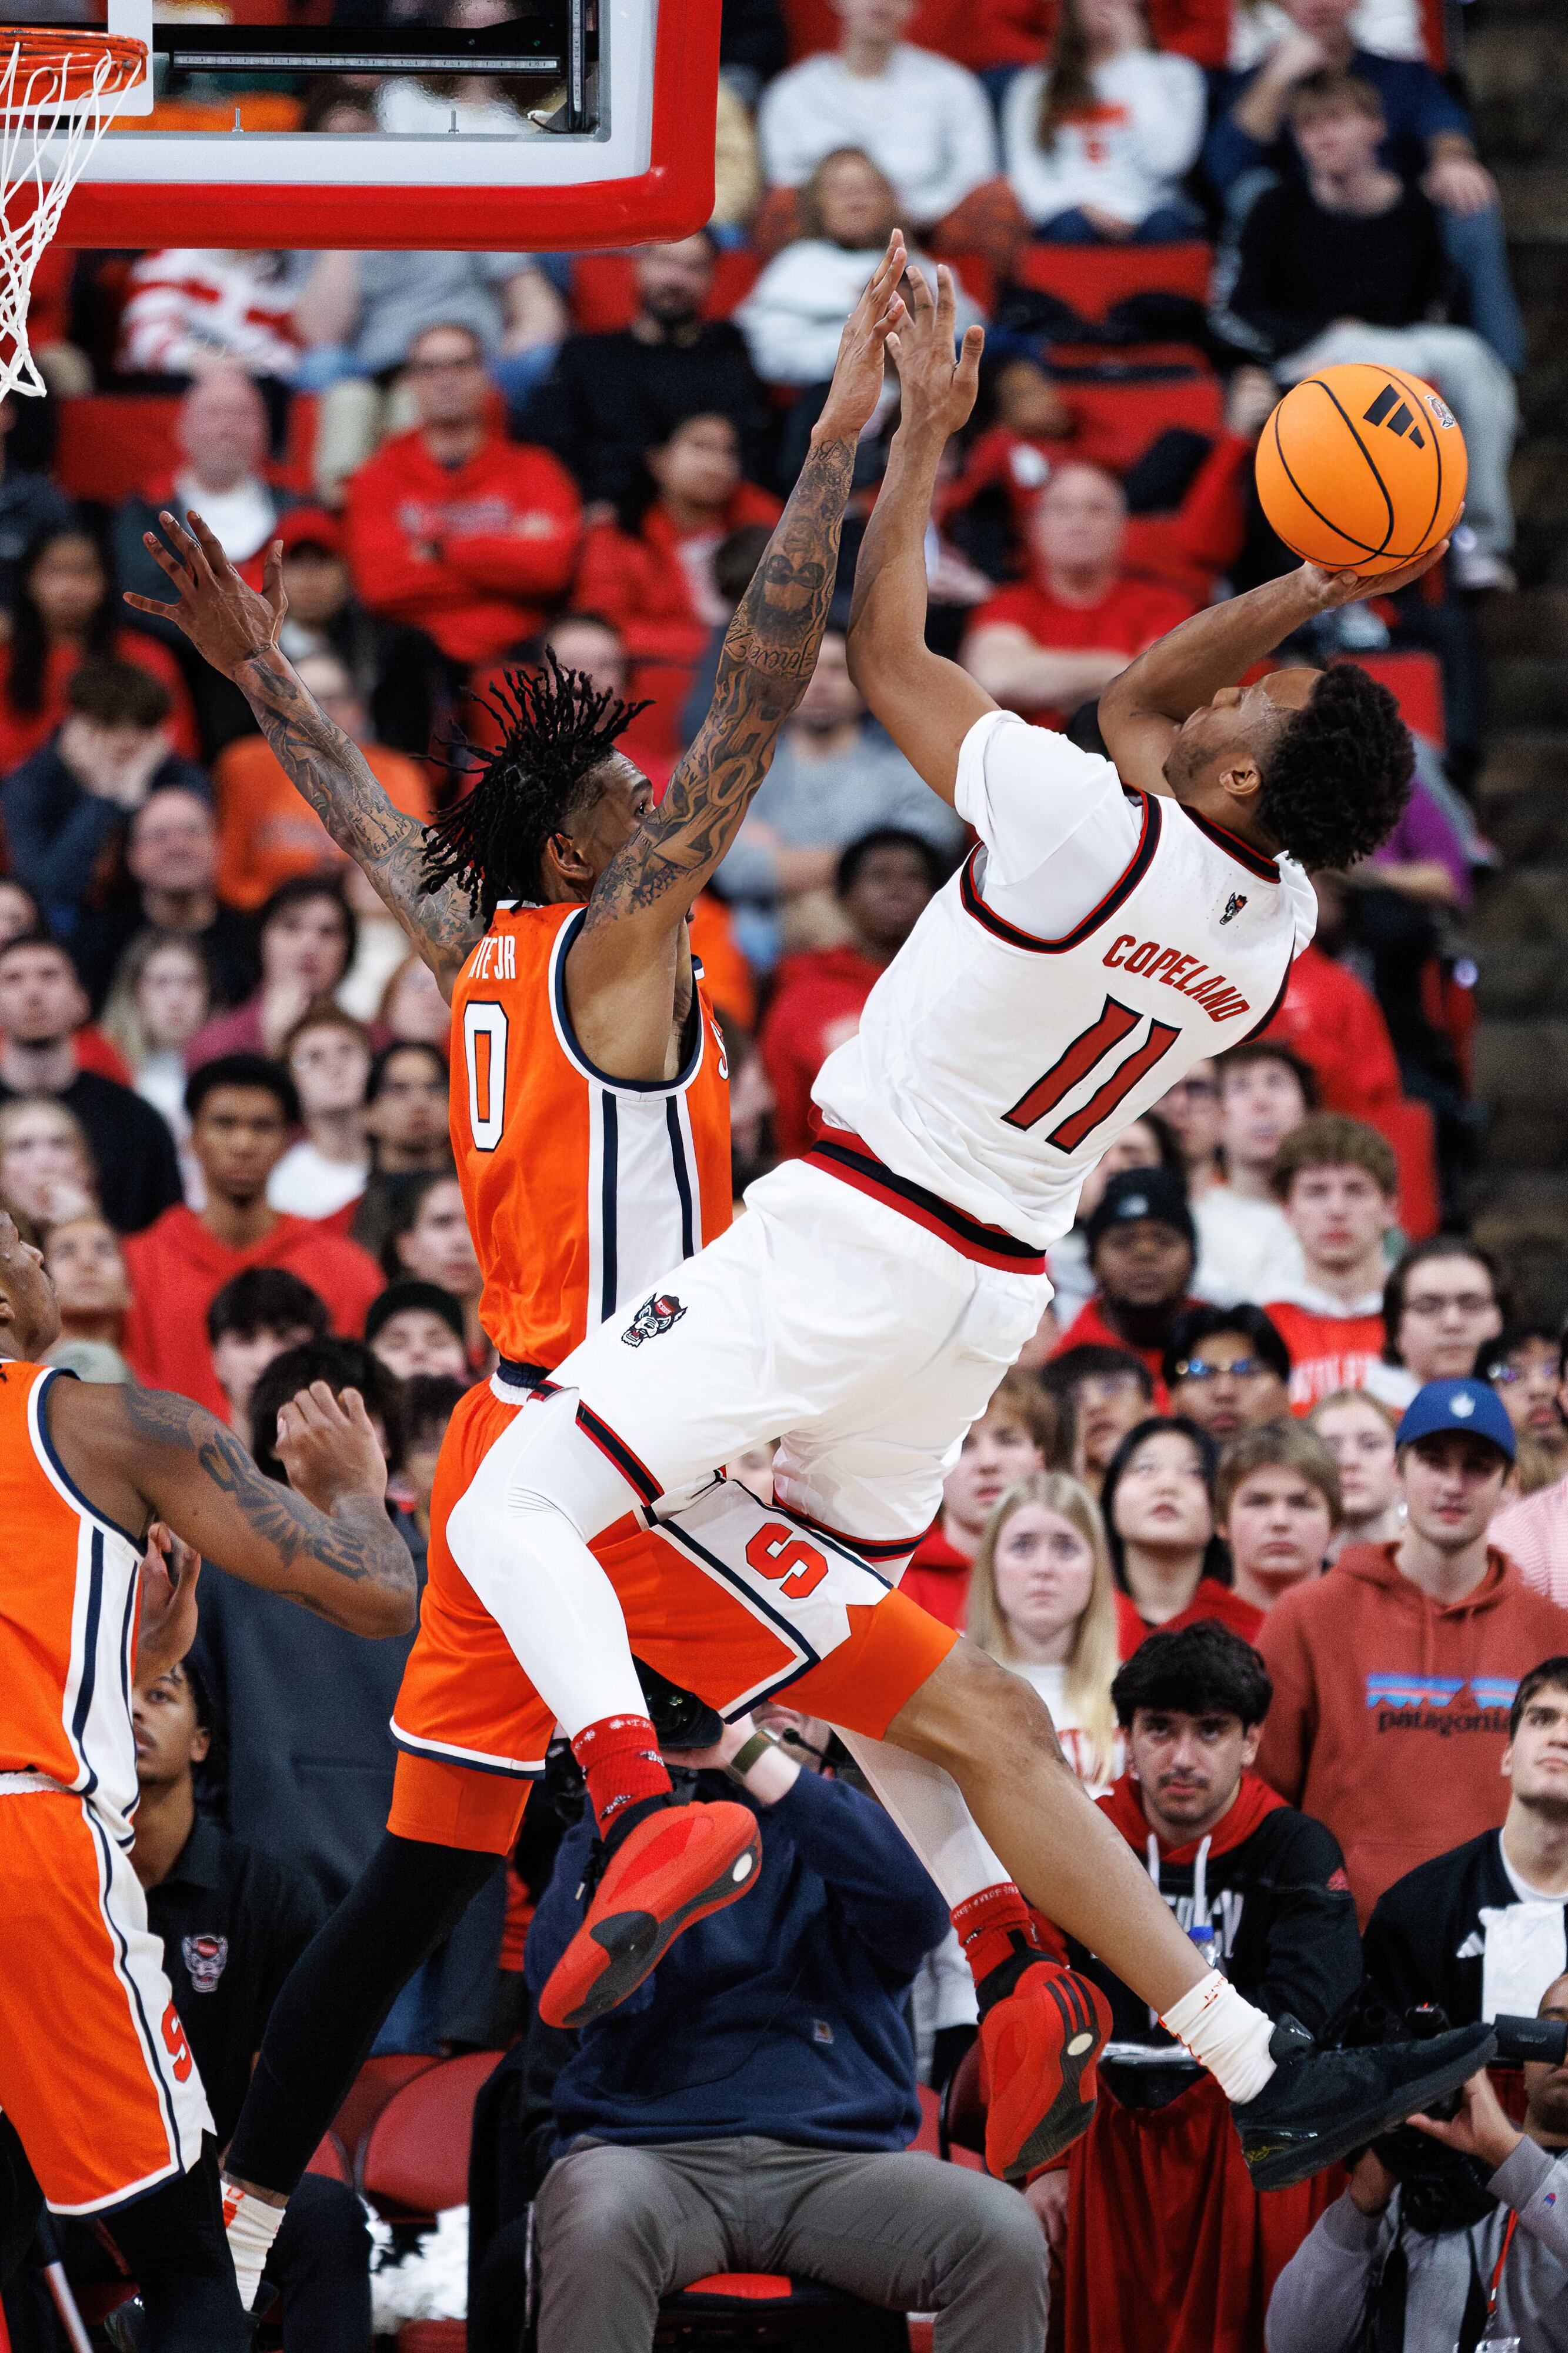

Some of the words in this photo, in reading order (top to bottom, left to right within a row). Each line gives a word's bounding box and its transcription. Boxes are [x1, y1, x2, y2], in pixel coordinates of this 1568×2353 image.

[494, 935, 516, 979] JR
[1102, 934, 1250, 1022] COPELAND
[463, 1001, 509, 1152] 0
[1000, 993, 1183, 1155] 11
[745, 1522, 829, 1599] S
